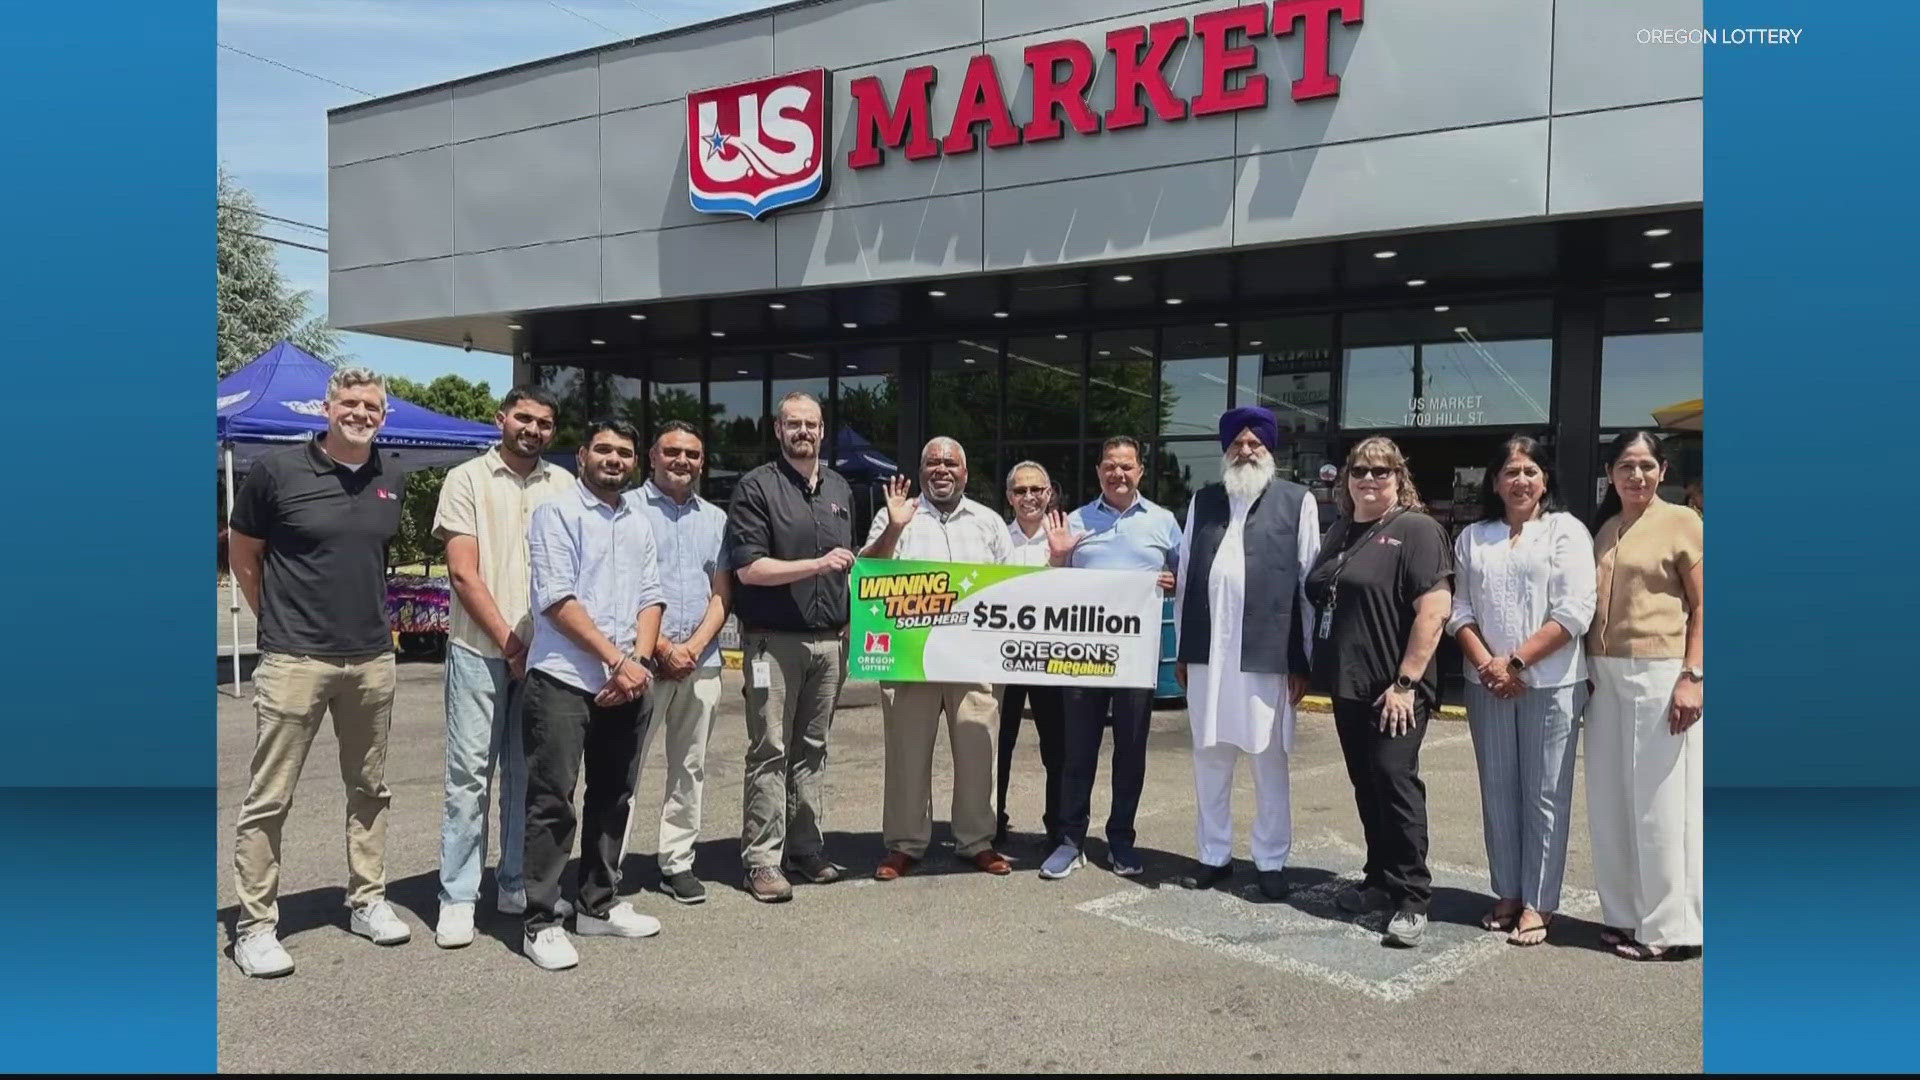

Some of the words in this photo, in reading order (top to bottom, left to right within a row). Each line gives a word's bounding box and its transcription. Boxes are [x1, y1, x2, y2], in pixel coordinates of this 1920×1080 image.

[848, 0, 1363, 169] MARKET
[1408, 397, 1425, 411] US
[1429, 395, 1483, 411] MARKET
[1403, 413, 1431, 426] 1709
[1436, 413, 1463, 426] HILL
[859, 572, 949, 600] WINNING
[884, 592, 957, 618] TICKET
[896, 615, 932, 629] SOLD
[932, 612, 968, 626] HERE
[973, 601, 1037, 631] $5.6
[1043, 605, 1141, 634] Million
[857, 656, 895, 664] OREGON
[1000, 640, 1119, 662] OREGON'S
[1002, 659, 1046, 672] GAME
[1046, 660, 1116, 677] megabucks
